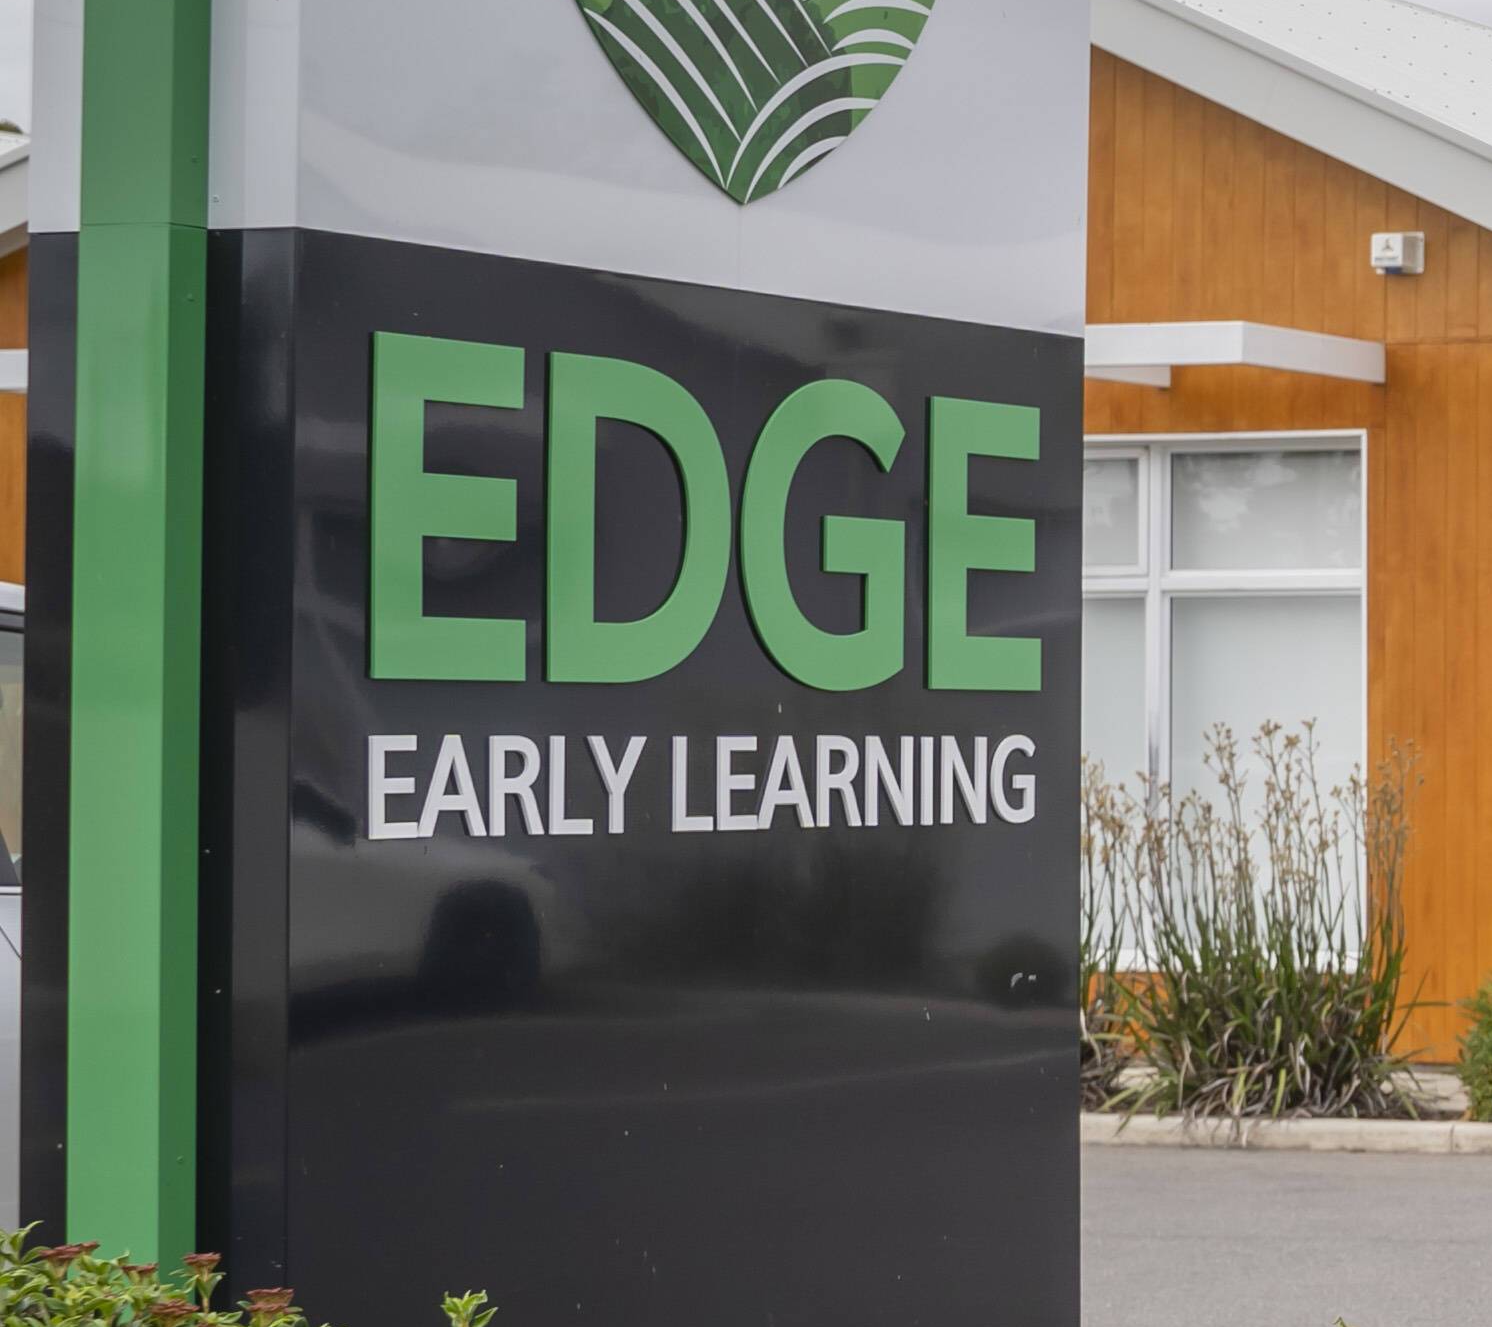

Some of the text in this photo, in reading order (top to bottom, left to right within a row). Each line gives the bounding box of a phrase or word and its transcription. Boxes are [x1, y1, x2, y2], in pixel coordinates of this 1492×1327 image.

[368, 331, 1042, 691] EDGE
[368, 734, 1036, 840] EARLY LEARNING
